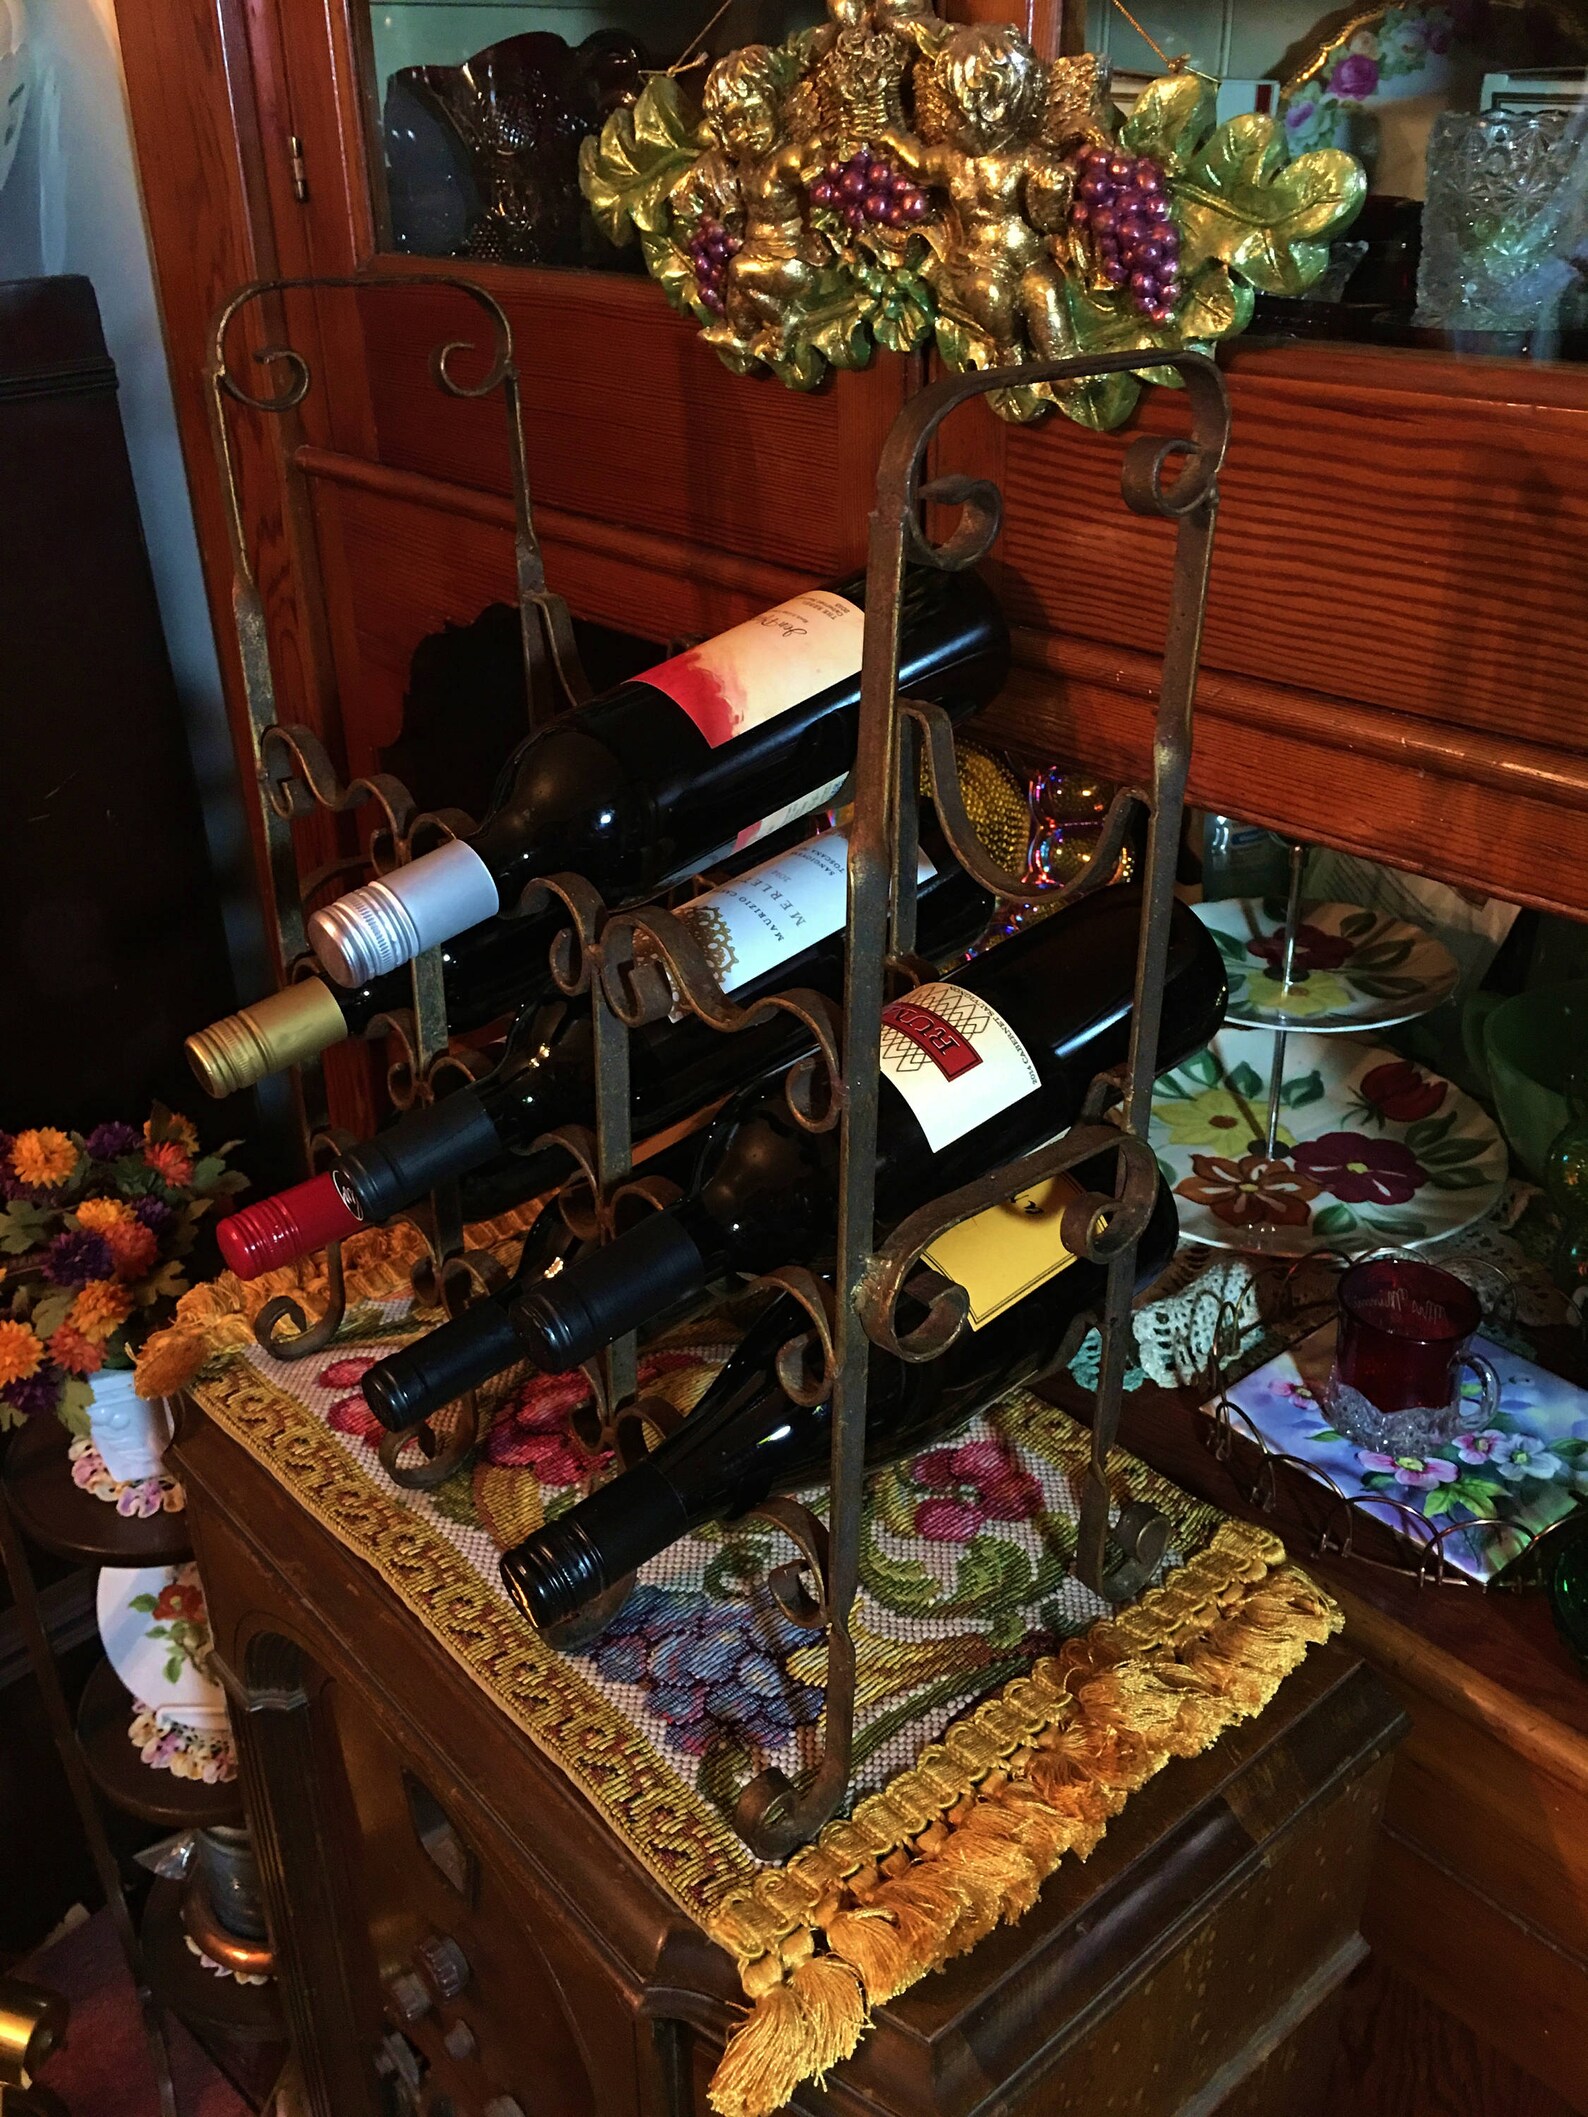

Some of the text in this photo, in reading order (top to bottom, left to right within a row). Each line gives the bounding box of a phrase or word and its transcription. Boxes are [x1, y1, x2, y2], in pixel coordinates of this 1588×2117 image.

[738, 896, 785, 942] MAURIZIO
[949, 985, 1037, 1085] 2014 CABERNET SAUVIGNON
